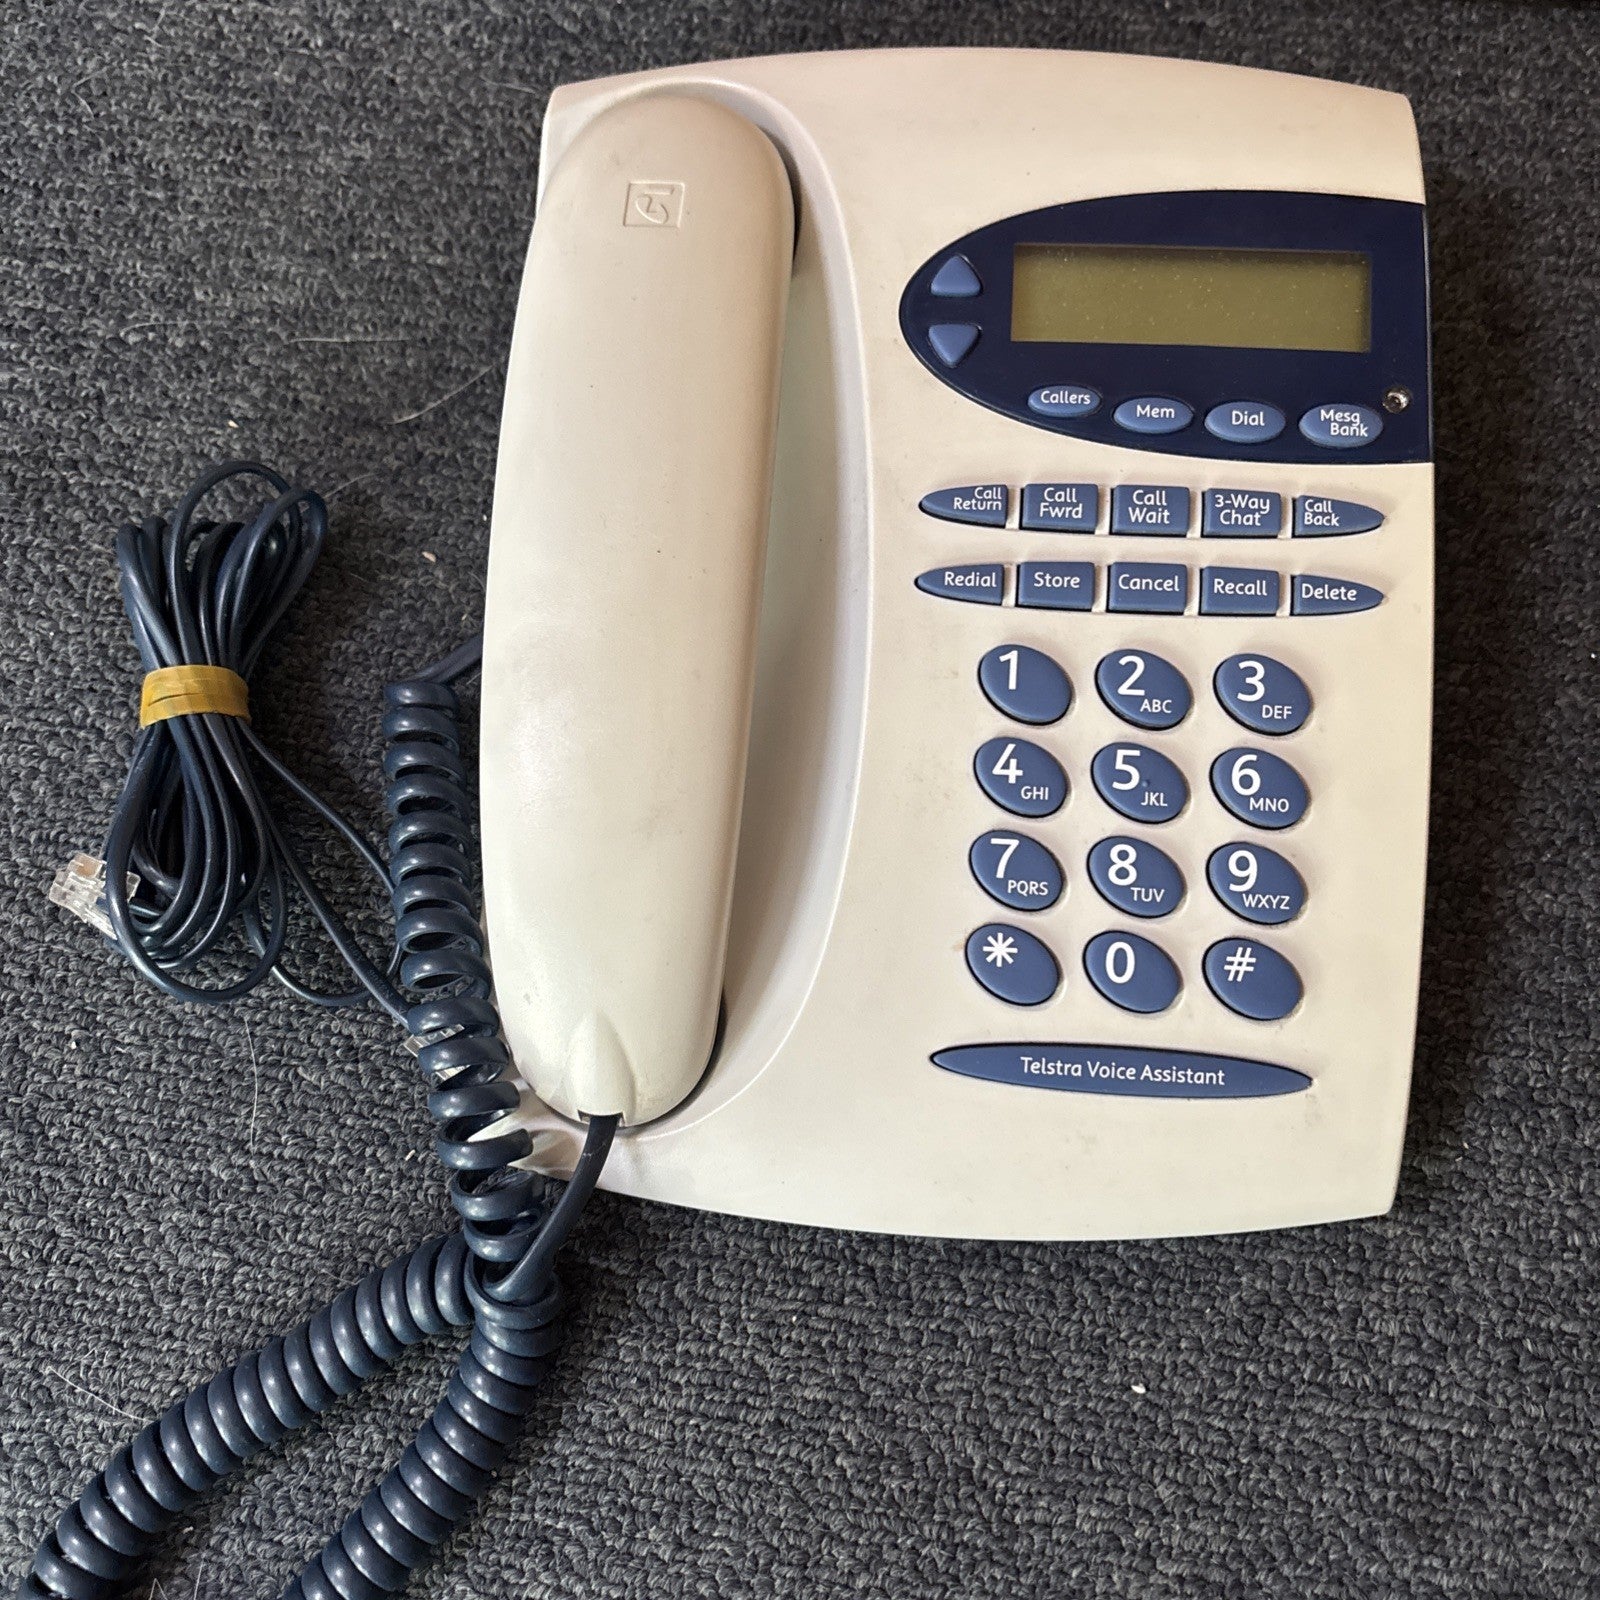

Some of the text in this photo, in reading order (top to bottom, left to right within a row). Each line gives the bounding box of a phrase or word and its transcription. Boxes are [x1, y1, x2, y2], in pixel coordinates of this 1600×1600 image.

[1040, 390, 1091, 406] Callers
[1137, 405, 1174, 418] Mem
[1232, 410, 1264, 426] Dial
[1320, 409, 1362, 425] Mesg
[1331, 422, 1369, 438] Bank
[974, 486, 1002, 499] Call
[1042, 488, 1078, 503] Call
[1133, 490, 1166, 505] Call
[954, 497, 1001, 510] Return
[1040, 503, 1082, 518] Fwrd
[1215, 494, 1270, 513] 3-Way
[1304, 499, 1333, 513] Call
[1129, 507, 1169, 524] Wait
[1220, 509, 1262, 526] Chat
[1304, 512, 1340, 527] Back
[945, 572, 996, 587] Redial
[1034, 572, 1080, 588] Store
[1119, 574, 1179, 591] Cancel
[1214, 579, 1267, 595] Recall
[1302, 582, 1358, 601] Delete
[999, 650, 1018, 689] 1
[1118, 656, 1145, 695] 2
[1237, 661, 1265, 701] 3
[1140, 699, 1171, 713] ABC
[1262, 705, 1292, 719] DEF
[992, 744, 1023, 783] 4
[1112, 749, 1140, 790] 5
[1232, 755, 1261, 796] 6
[1021, 786, 1048, 800] GHI
[1141, 792, 1167, 806] JKL
[1250, 797, 1289, 812] MNO
[991, 838, 1019, 878] 7
[1108, 844, 1138, 887] 8
[1229, 850, 1257, 891] 9
[1008, 880, 1048, 896] PQRS
[1131, 887, 1164, 902] TUV
[1243, 894, 1289, 909] WXYZ
[1106, 942, 1135, 983] 0
[1224, 947, 1256, 981] #
[1021, 1057, 1224, 1085] Telstra Voice Assistant
